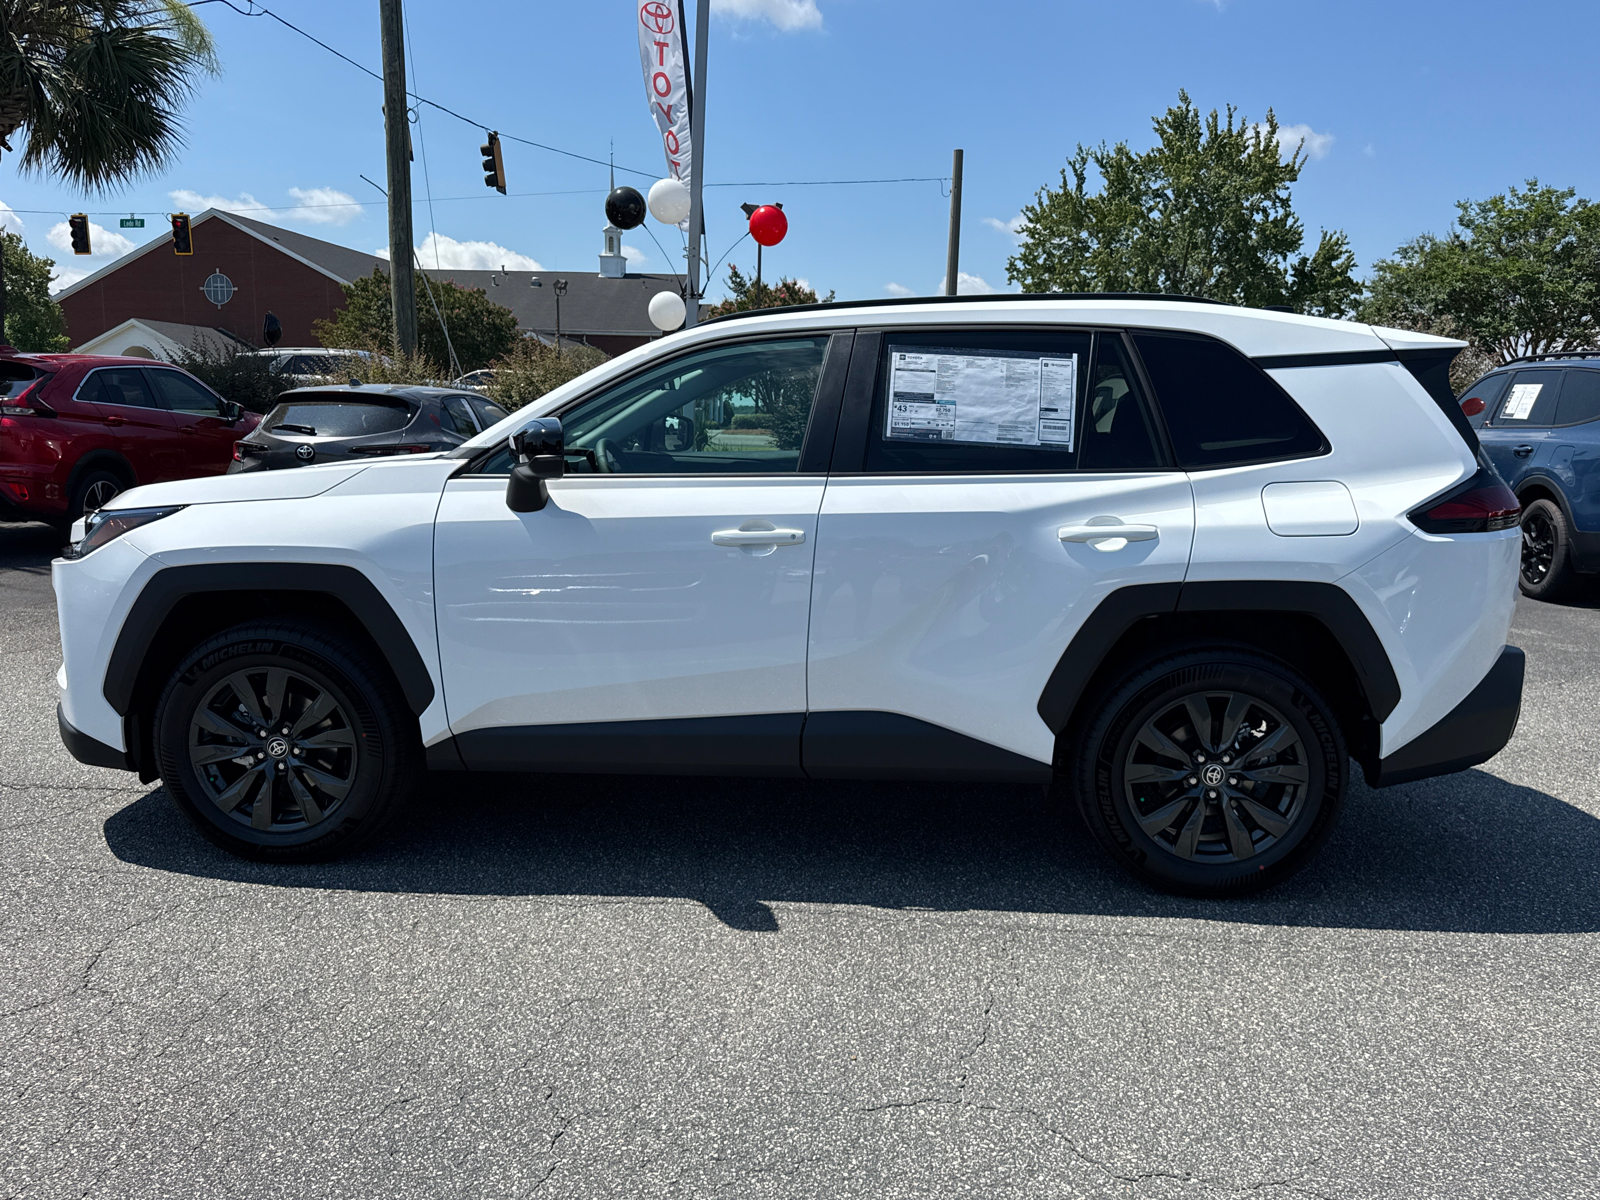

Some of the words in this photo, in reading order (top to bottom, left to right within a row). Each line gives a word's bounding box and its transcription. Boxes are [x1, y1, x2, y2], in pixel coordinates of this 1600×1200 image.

[653, 41, 681, 181] TOYOT
[202, 642, 275, 670] MICHELIN
[296, 652, 333, 674] PRIMACY
[1108, 710, 1131, 747] PRIMACY
[1309, 713, 1339, 790] MICHELIN
[1098, 767, 1130, 843] MICHELIN
